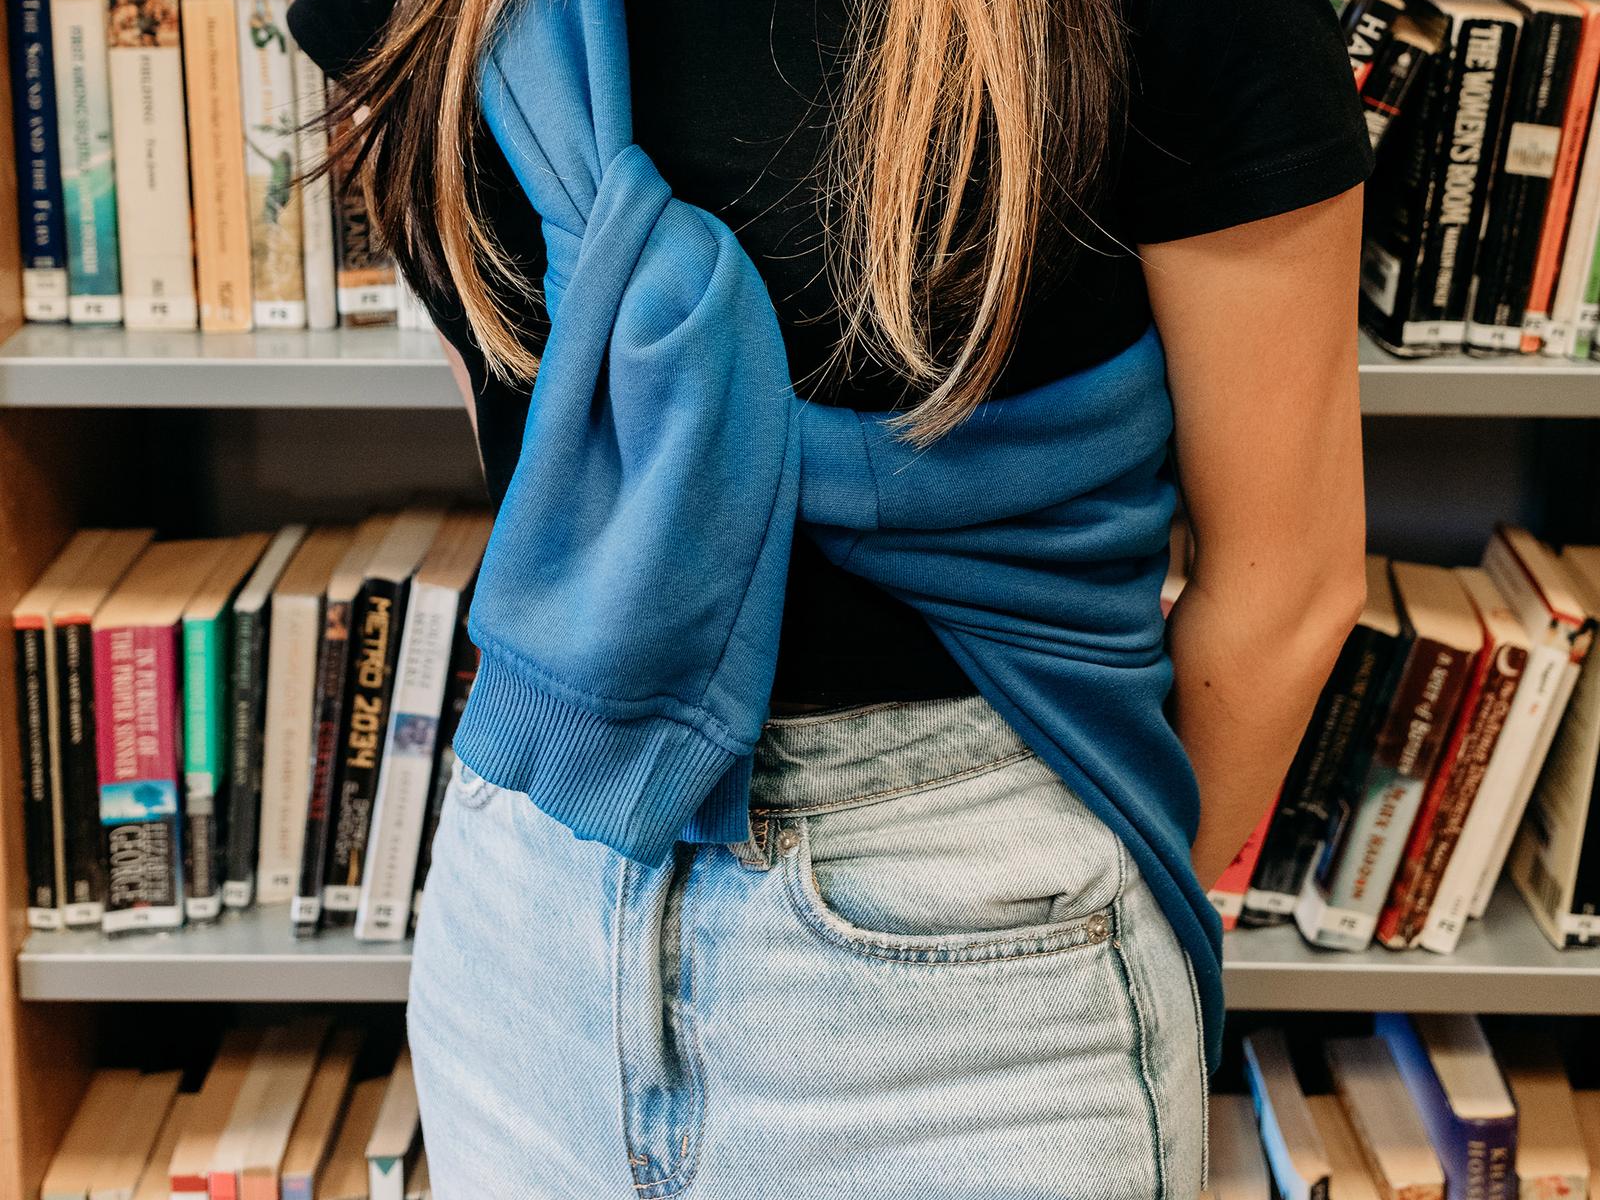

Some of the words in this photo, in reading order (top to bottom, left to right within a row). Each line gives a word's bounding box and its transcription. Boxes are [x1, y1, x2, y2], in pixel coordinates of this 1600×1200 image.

[1463, 23, 1502, 72] THE
[1449, 70, 1495, 165] WOMEN'S
[1439, 162, 1479, 225] ROOM
[111, 631, 135, 663] THE
[135, 648, 158, 667] IN
[357, 596, 393, 689] METRO
[111, 664, 136, 722] PROPER
[136, 669, 159, 732] PURSUIT
[113, 723, 137, 779] SINNER
[137, 735, 160, 757] OF
[346, 693, 382, 769] 2034
[109, 824, 147, 906] GEORGE
[145, 822, 169, 904] ELIZABETH
